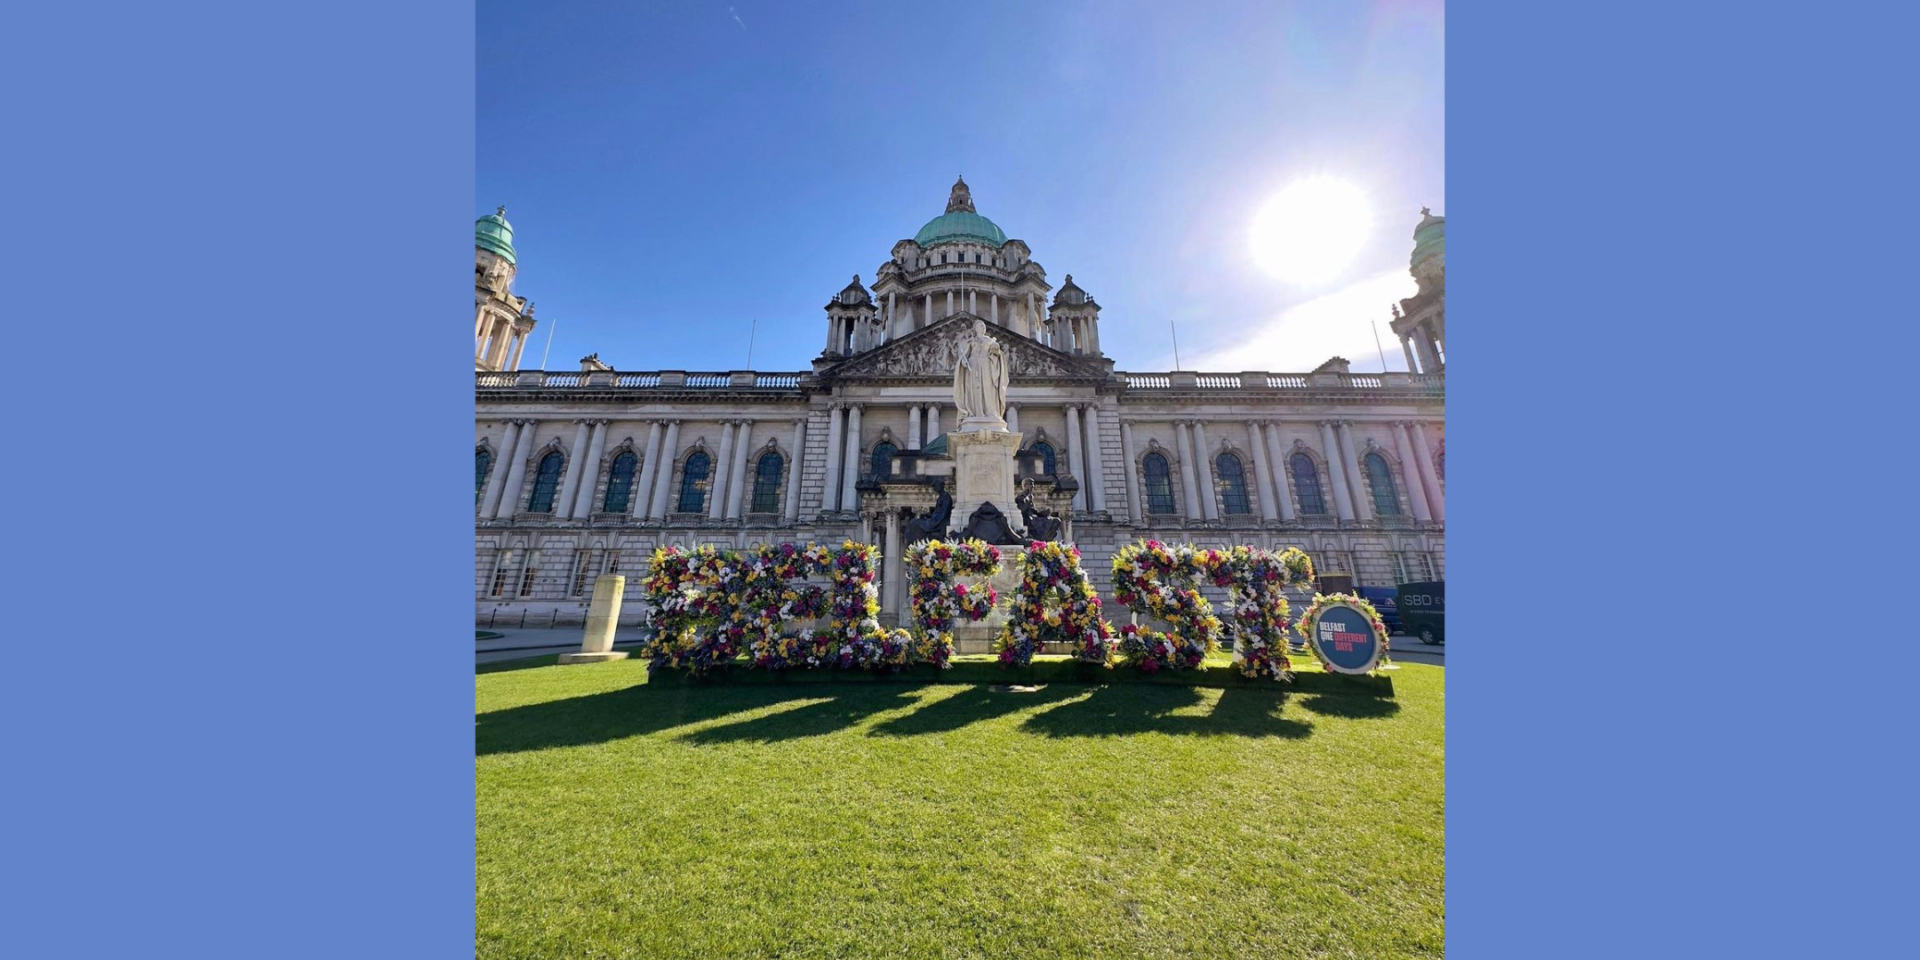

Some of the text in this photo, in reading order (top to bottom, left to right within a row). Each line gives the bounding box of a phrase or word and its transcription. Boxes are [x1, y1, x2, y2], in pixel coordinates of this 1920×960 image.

[1404, 595, 1432, 605] SBD
[643, 538, 1312, 681] BELFAST
[1319, 622, 1346, 632] BELFAST
[1334, 633, 1367, 643] DIFFERENT
[1335, 642, 1352, 651] DAYS
